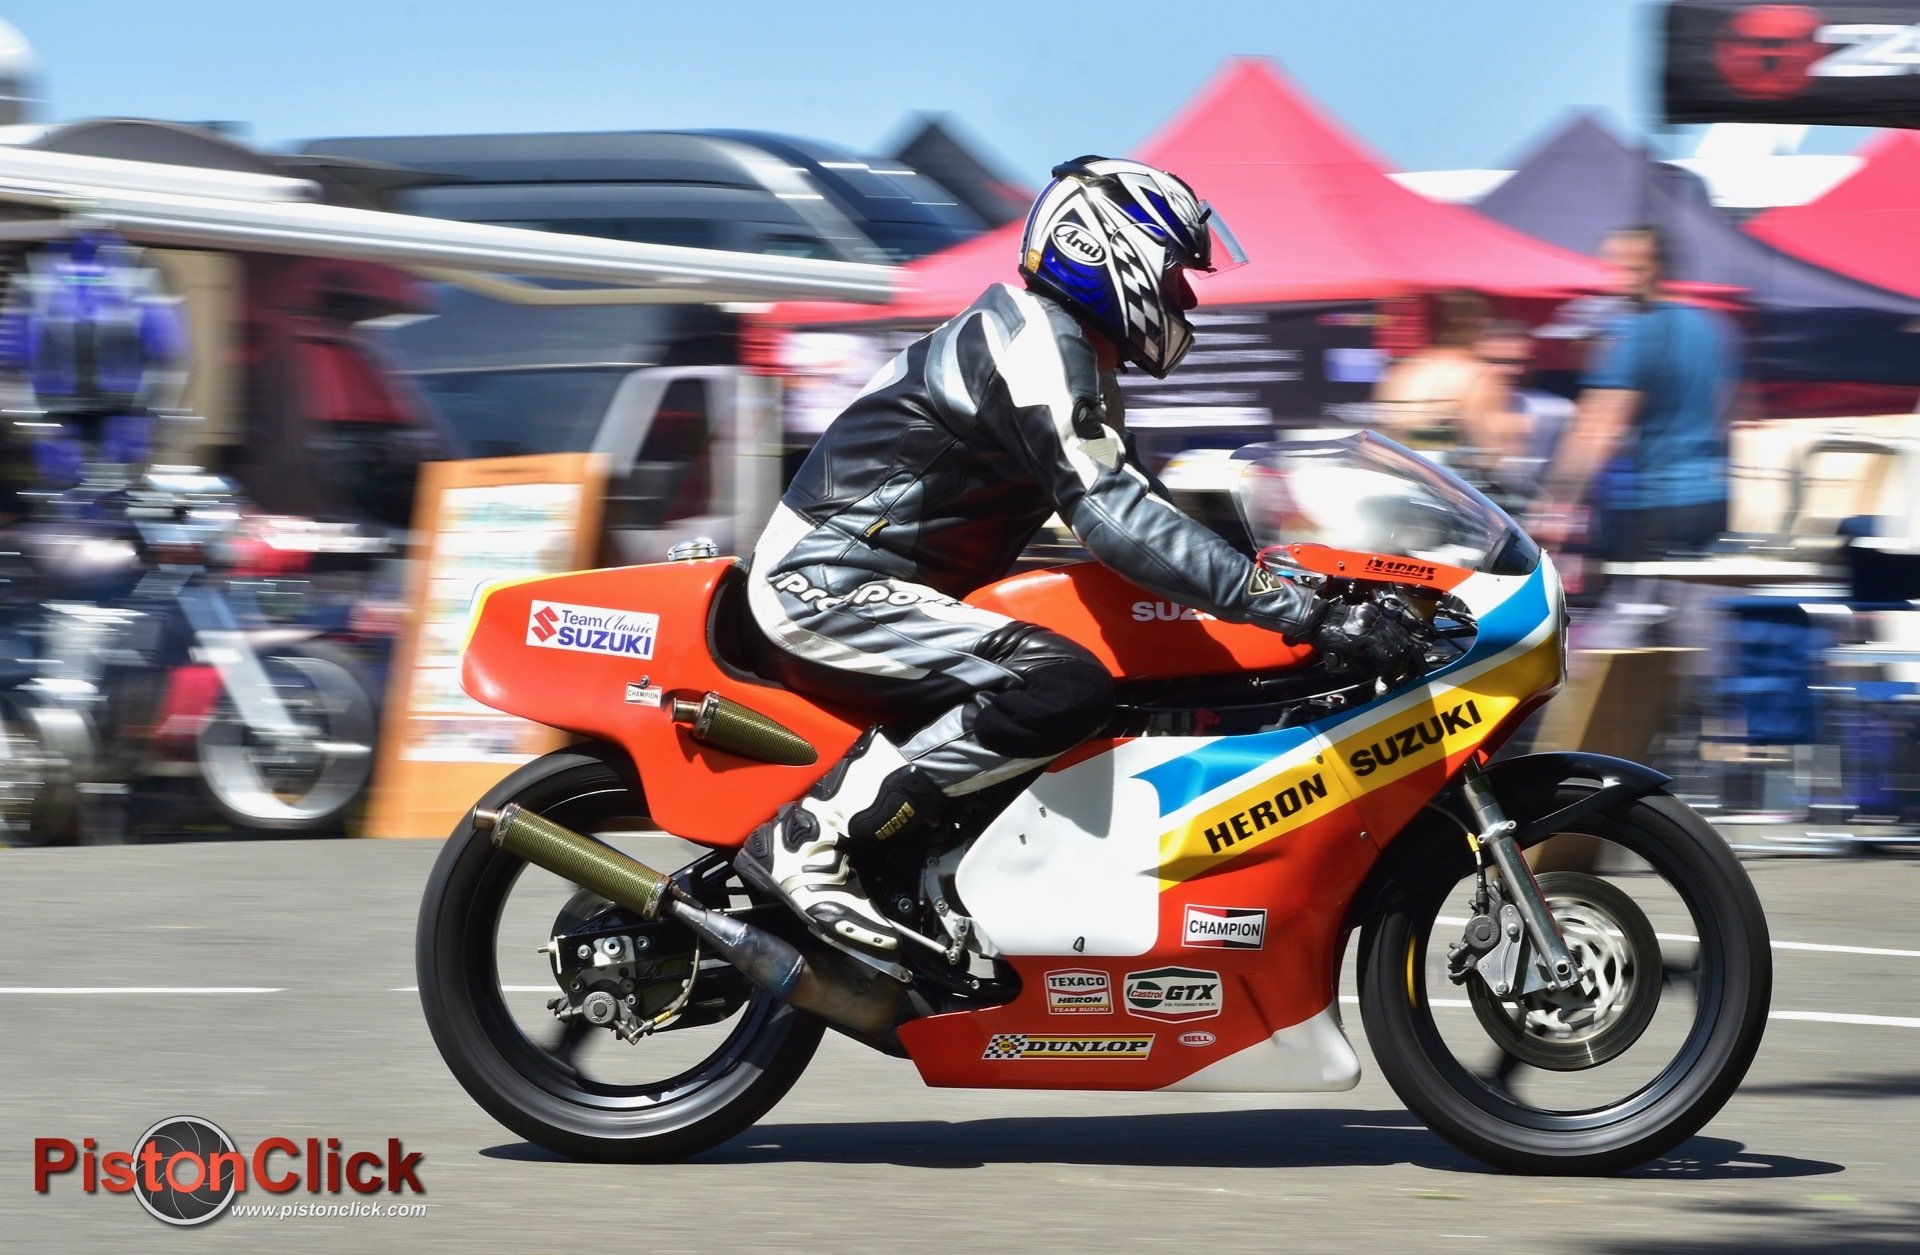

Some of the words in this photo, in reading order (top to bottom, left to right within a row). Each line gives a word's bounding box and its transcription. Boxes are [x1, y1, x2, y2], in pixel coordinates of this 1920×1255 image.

[1055, 229, 1102, 258] Arai
[561, 609, 603, 628] Team
[603, 613, 653, 635] Classic
[557, 626, 651, 656] SUZUKI
[627, 689, 659, 700] CHAMPION
[1203, 773, 1328, 854] HERON
[1349, 699, 1482, 777] SUZUKI
[1189, 919, 1261, 937] CHAMPION
[1049, 976, 1105, 987] TEXACO
[1057, 996, 1103, 1004] HERON
[1130, 990, 1163, 999] Castrol
[1164, 984, 1218, 1001] GTX
[1023, 1041, 1148, 1052] DUNLOP
[1183, 1034, 1210, 1043] BELL
